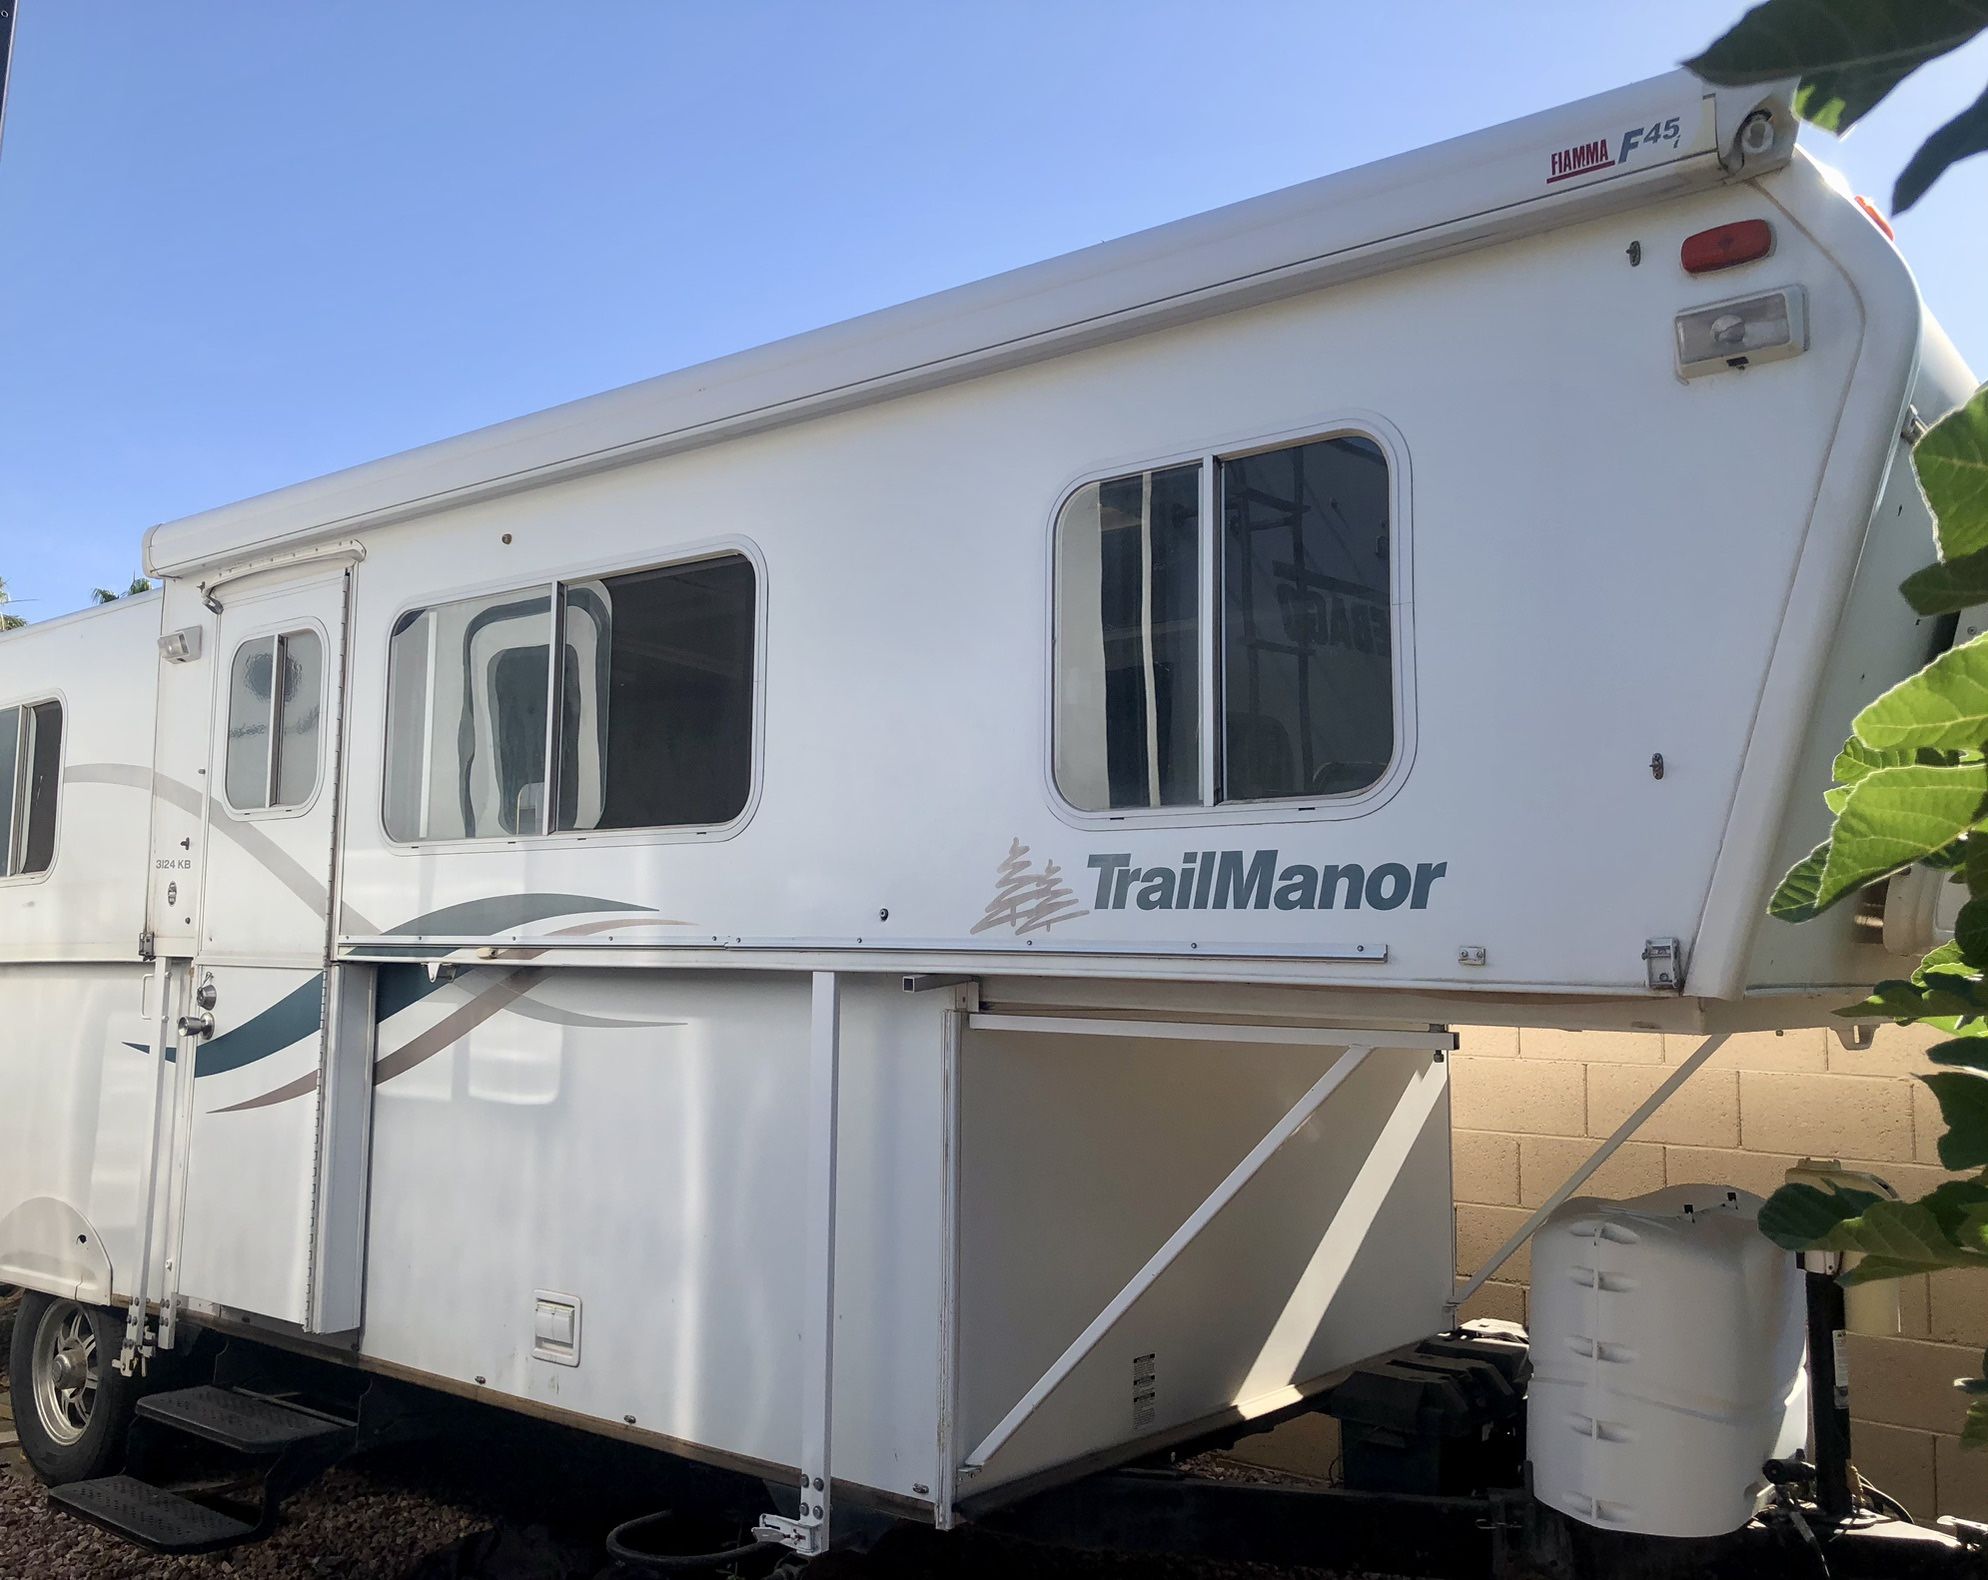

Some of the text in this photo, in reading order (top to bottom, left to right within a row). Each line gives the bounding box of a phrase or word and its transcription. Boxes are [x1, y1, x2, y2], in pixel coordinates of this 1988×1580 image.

[1551, 139, 1609, 176] FIAMMA
[155, 859, 191, 869] 3124 KB
[1087, 849, 1448, 911] TrailManor
